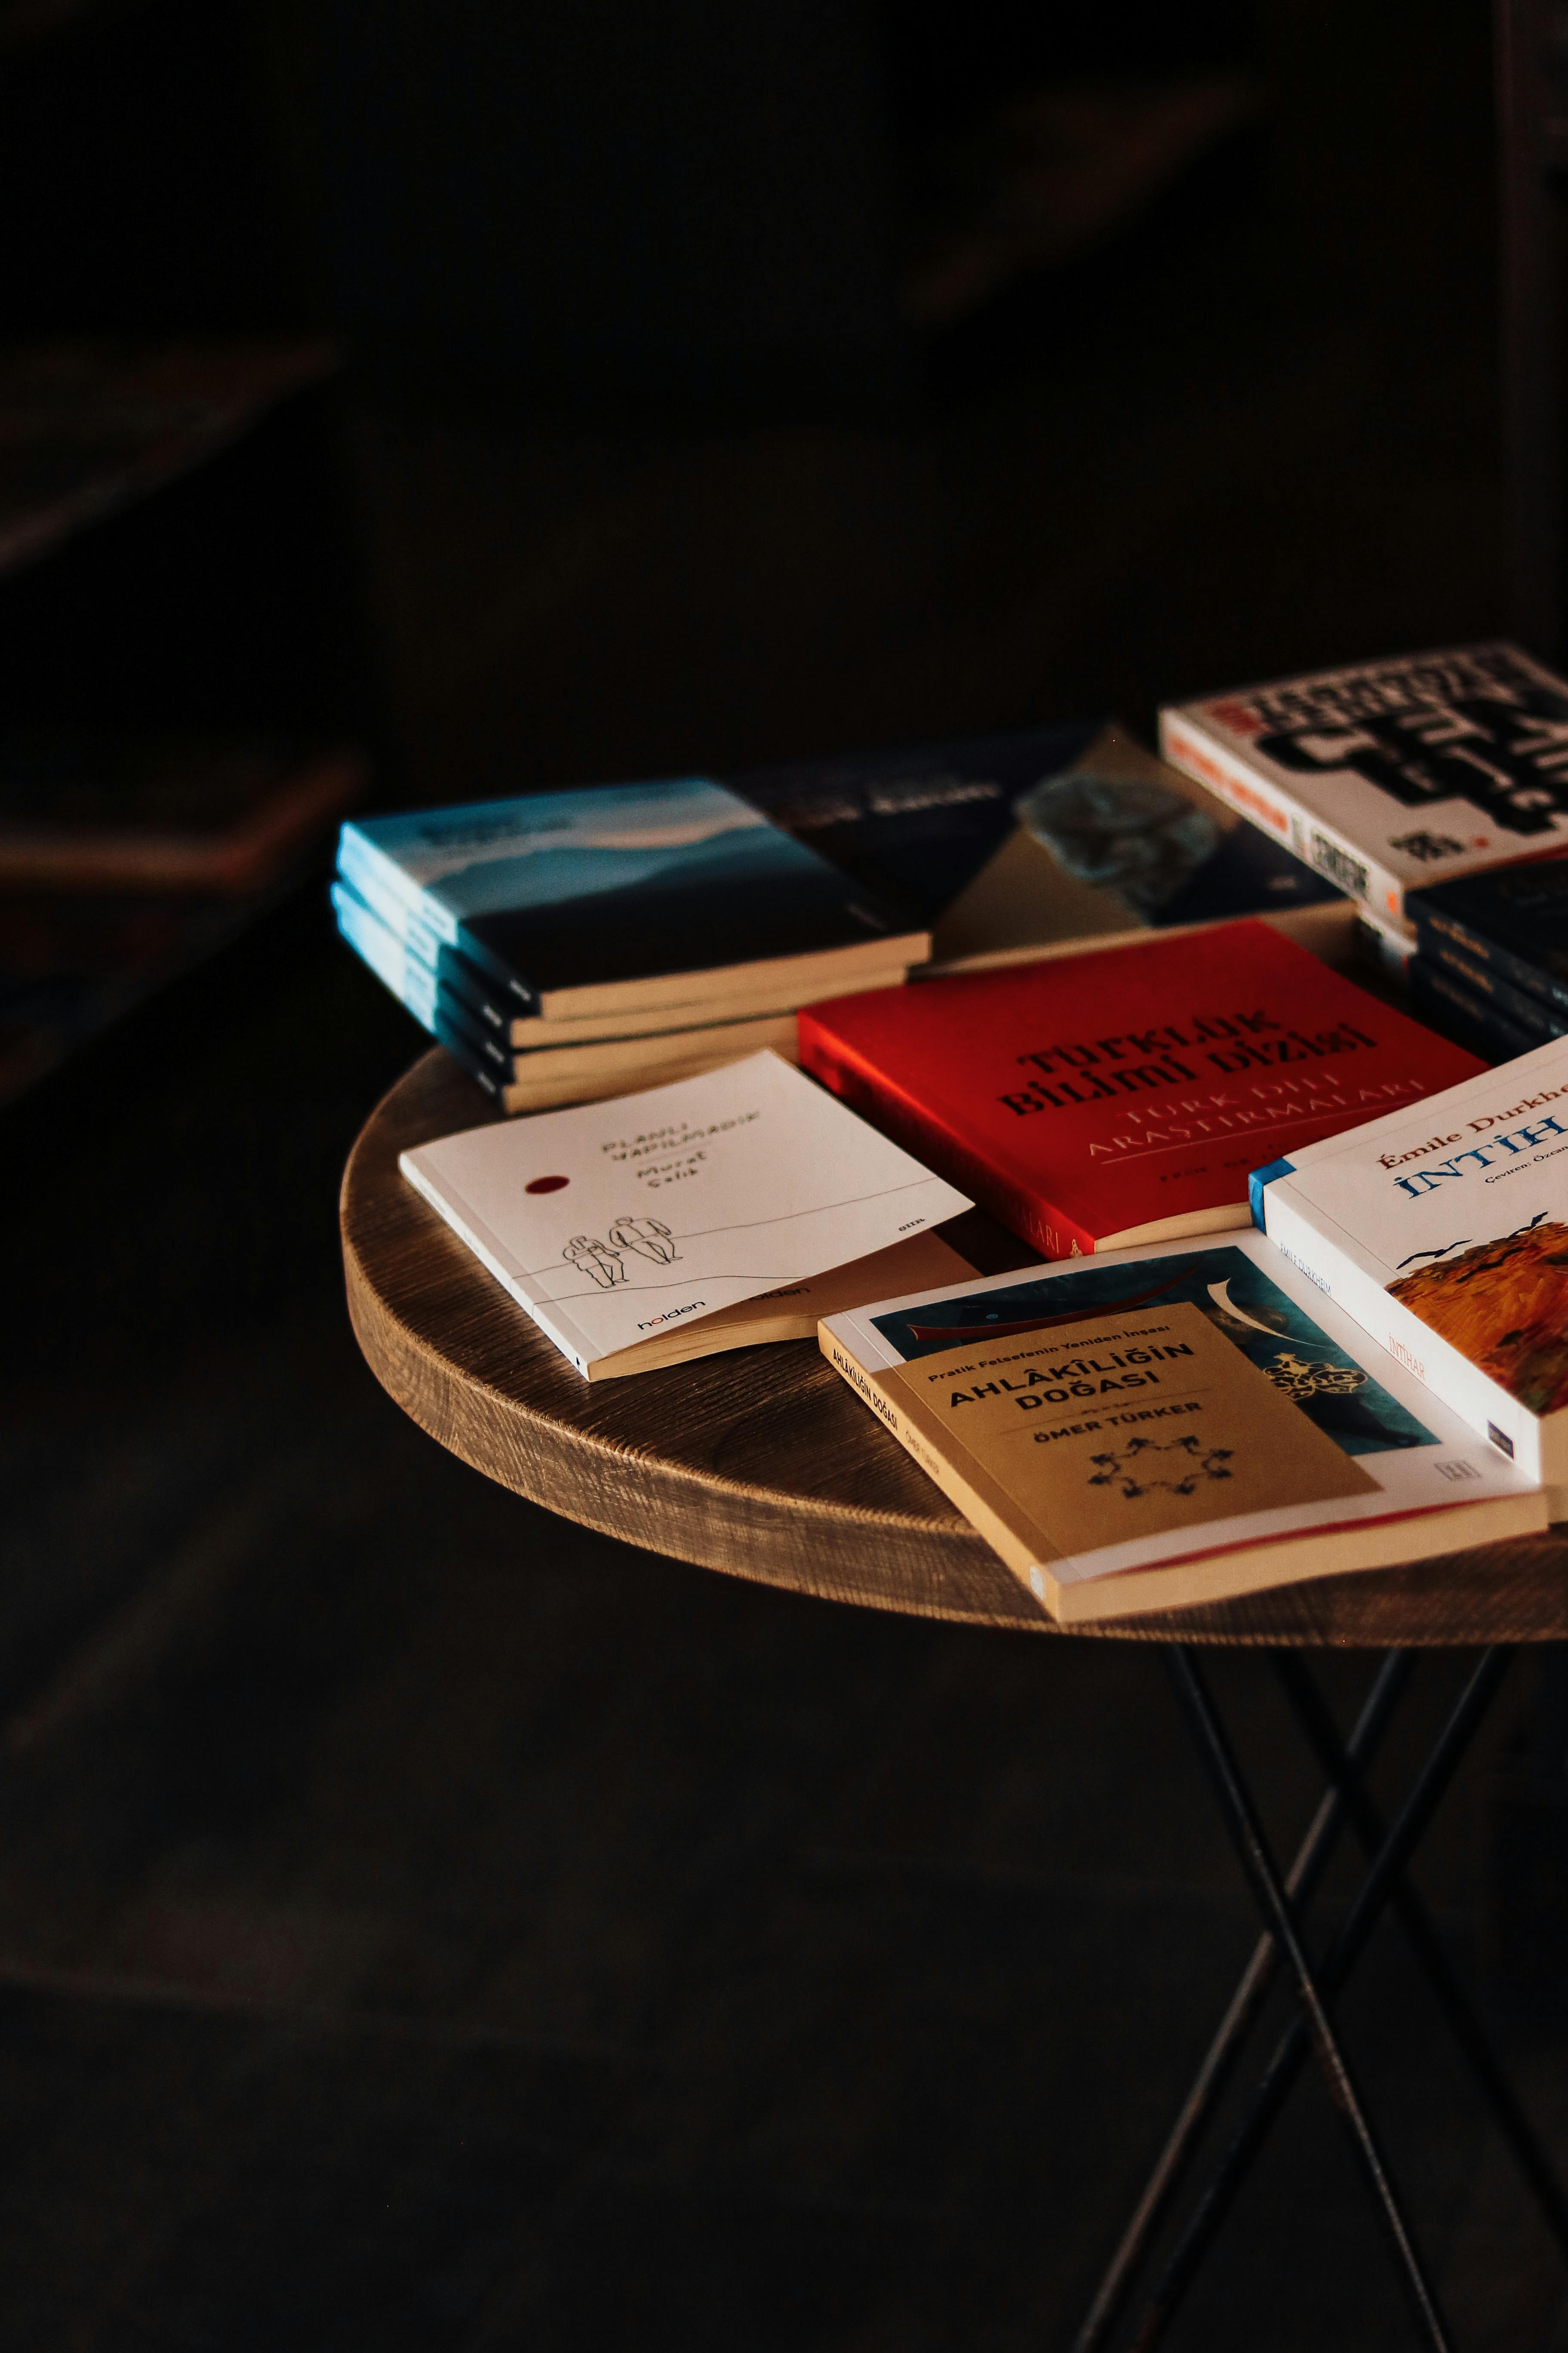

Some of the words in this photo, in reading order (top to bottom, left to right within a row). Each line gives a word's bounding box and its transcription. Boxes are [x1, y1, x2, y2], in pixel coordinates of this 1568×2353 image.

[1377, 1133, 1462, 1170] Émile
[1485, 1162, 1531, 1183] Çeviren:
[740, 1287, 810, 1303] olden
[1298, 1259, 1331, 1297] DURKHEIM
[637, 1301, 706, 1330] holden
[928, 1365, 975, 1382] Pratik
[978, 1346, 1059, 1367] Felsefenin
[1061, 1334, 1122, 1349] Yeniden
[1122, 1326, 1170, 1337] İnşası
[1389, 1332, 1425, 1381] İNTİHAR
[833, 1349, 871, 1401] AHLÂKÎLİĞİN
[873, 1392, 898, 1431] DOĞASI
[951, 1343, 1194, 1407] AHLÂKÎLİĞİN
[1015, 1371, 1160, 1410] DOĞASI
[1034, 1421, 1102, 1443] ÖMER
[1105, 1402, 1202, 1426] TÜRKER
